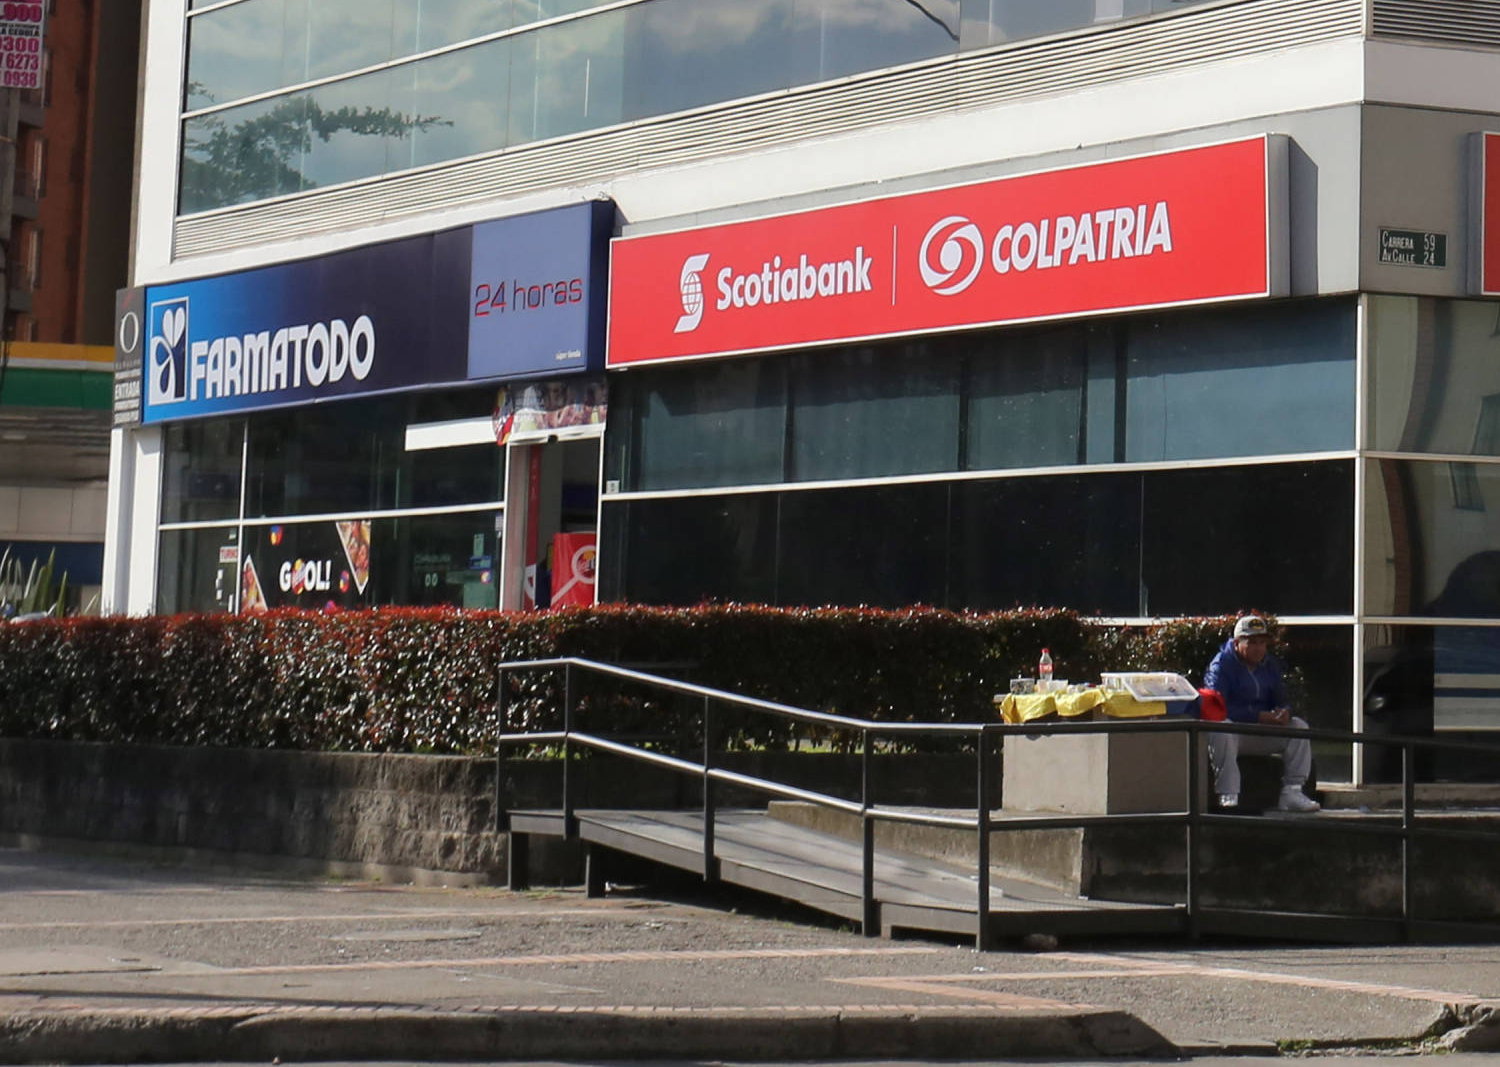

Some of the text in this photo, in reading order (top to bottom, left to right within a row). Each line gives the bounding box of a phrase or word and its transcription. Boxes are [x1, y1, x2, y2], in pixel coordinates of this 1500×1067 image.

[6, 53, 38, 70] 6273
[4, 71, 37, 87] 0938
[1424, 234, 1436, 251] 59
[717, 201, 1172, 311] Scotiabank COLPATRIA
[1423, 251, 1436, 265] 24
[475, 279, 583, 317] 24 horas
[189, 315, 375, 401] FARMATODO
